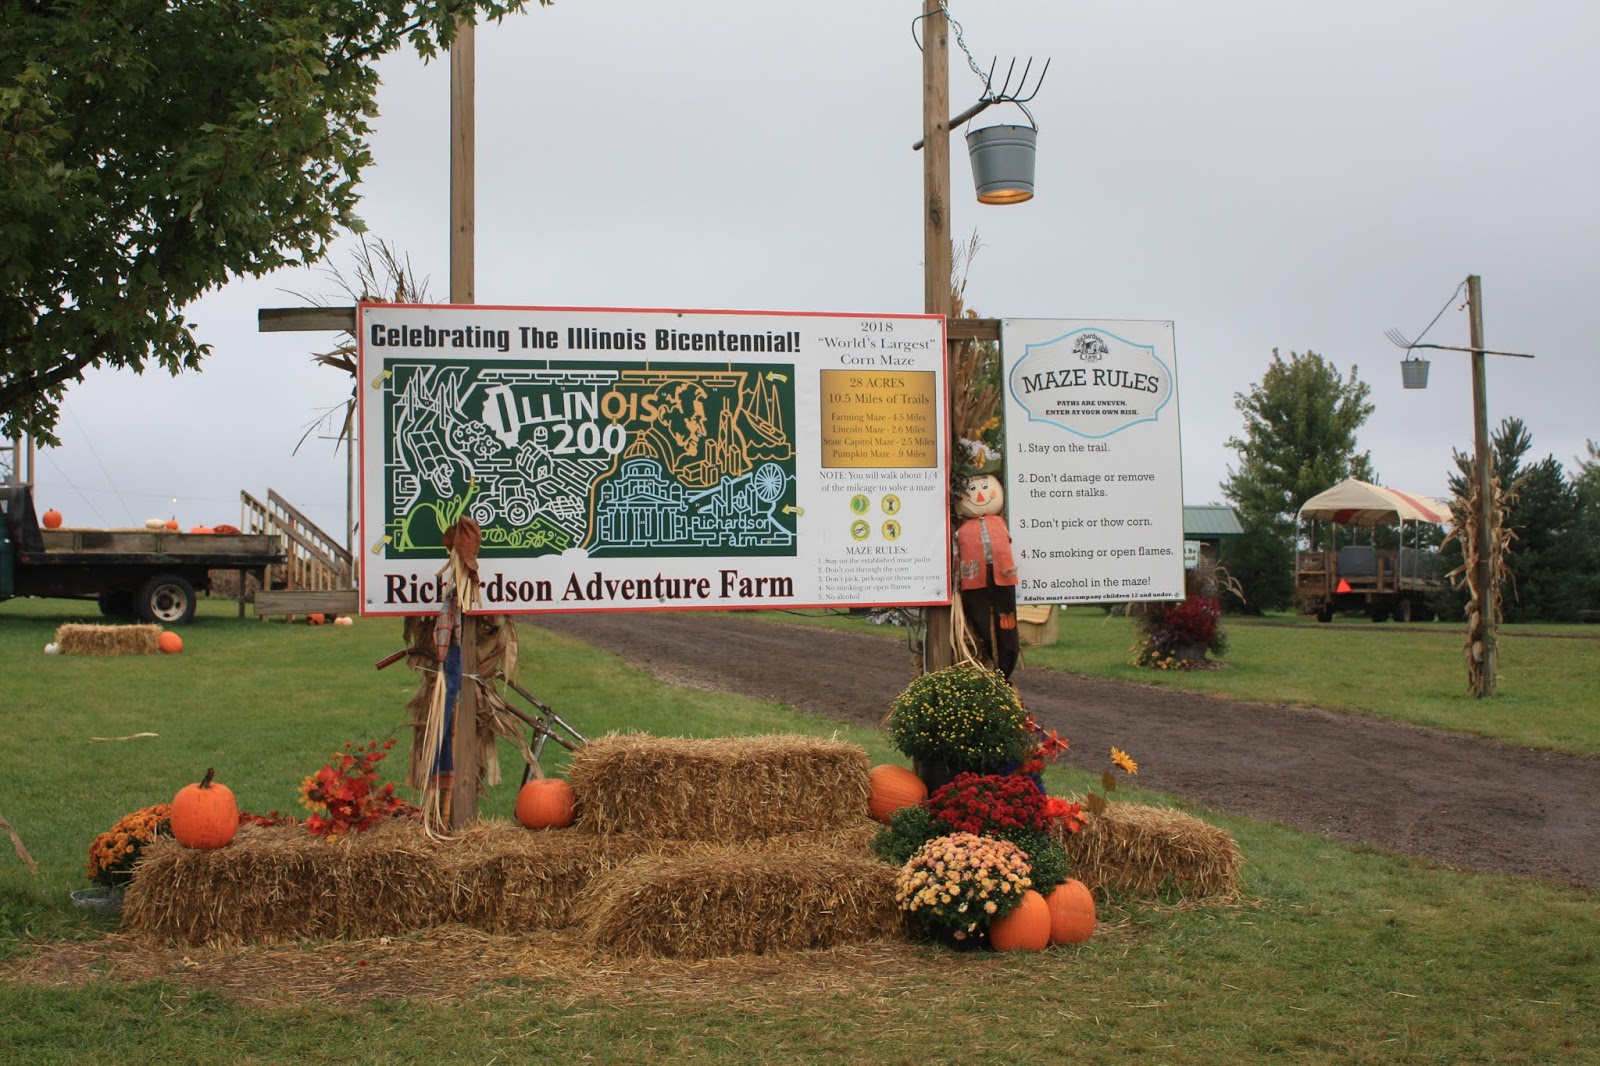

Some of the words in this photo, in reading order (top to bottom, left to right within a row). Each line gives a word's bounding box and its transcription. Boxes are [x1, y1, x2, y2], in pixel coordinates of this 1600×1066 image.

[860, 321, 893, 332] 2018
[371, 324, 510, 352] Celebrating
[519, 326, 558, 349] The
[568, 327, 646, 350] Illinois
[655, 329, 801, 353] Bicentennial!
[840, 354, 875, 366] Corn
[880, 354, 915, 366] Maze
[849, 378, 863, 388] 28
[866, 378, 905, 388] ACRES
[1022, 369, 1087, 394] MAZE
[1092, 369, 1159, 394] RULES
[829, 393, 851, 404] 10.5
[855, 393, 883, 404] Miles
[885, 393, 897, 404] of
[900, 393, 930, 404] Trails
[496, 391, 659, 434] ILLINOIS
[831, 412, 864, 423] Farming
[866, 413, 886, 421] Maze
[892, 413, 904, 421] 4.5
[906, 413, 927, 421] Miles
[832, 425, 863, 433] Lincoln
[865, 425, 885, 433] Maze
[891, 425, 903, 433] 2.6
[905, 425, 926, 433] Miles
[552, 422, 627, 455] 200
[823, 438, 841, 446] State
[844, 438, 873, 448] Capitol
[875, 438, 895, 446] Maze
[901, 438, 913, 446] 2.5
[914, 438, 935, 446] Miles
[1018, 444, 1026, 453] 1.
[1028, 443, 1050, 454] Stay
[1068, 443, 1085, 452] the
[1087, 443, 1111, 452] trail.
[832, 450, 868, 460] Pumpkin
[870, 450, 891, 458] Maze
[906, 450, 926, 458] Miles
[820, 471, 847, 479] NOTE:
[848, 471, 864, 479] You
[867, 471, 879, 479] will
[880, 471, 898, 479] walk
[899, 471, 922, 479] about
[924, 471, 938, 479] 1/4
[1018, 474, 1028, 483] 2.
[1029, 473, 1058, 483] Don't
[1060, 473, 1101, 484] damage
[1104, 474, 1115, 482] or
[1117, 474, 1155, 482] remove
[821, 484, 831, 492] of
[831, 484, 845, 492] the
[846, 484, 877, 494] mileage
[879, 484, 887, 492] to
[889, 484, 907, 492] solve
[1030, 488, 1047, 498] the
[1049, 490, 1074, 498] corn
[1075, 488, 1108, 497] stalks.
[692, 516, 771, 530] Richardson
[1019, 519, 1029, 529] 3.
[1031, 518, 1059, 528] Don't
[1061, 518, 1084, 530] pick
[1086, 519, 1098, 527] or
[1100, 517, 1125, 527] thow
[1126, 518, 1153, 526] corn.
[719, 532, 758, 546] Farm
[846, 546, 873, 555] MAZE
[875, 546, 908, 555] RULES:
[1020, 549, 1030, 559] 4.
[1031, 549, 1047, 558] No
[1049, 548, 1094, 560] smoking
[1096, 549, 1108, 557] or
[1110, 548, 1136, 559] open
[1138, 546, 1174, 556] flames.
[384, 573, 553, 604] Richrdson
[561, 571, 710, 602] Adventure
[718, 569, 794, 599] Farm
[1021, 580, 1031, 589] 5.
[1032, 579, 1048, 589] No
[1050, 578, 1088, 588] alcohol
[1091, 578, 1101, 587] in
[1103, 577, 1119, 587] the
[1121, 576, 1151, 586] maze!
